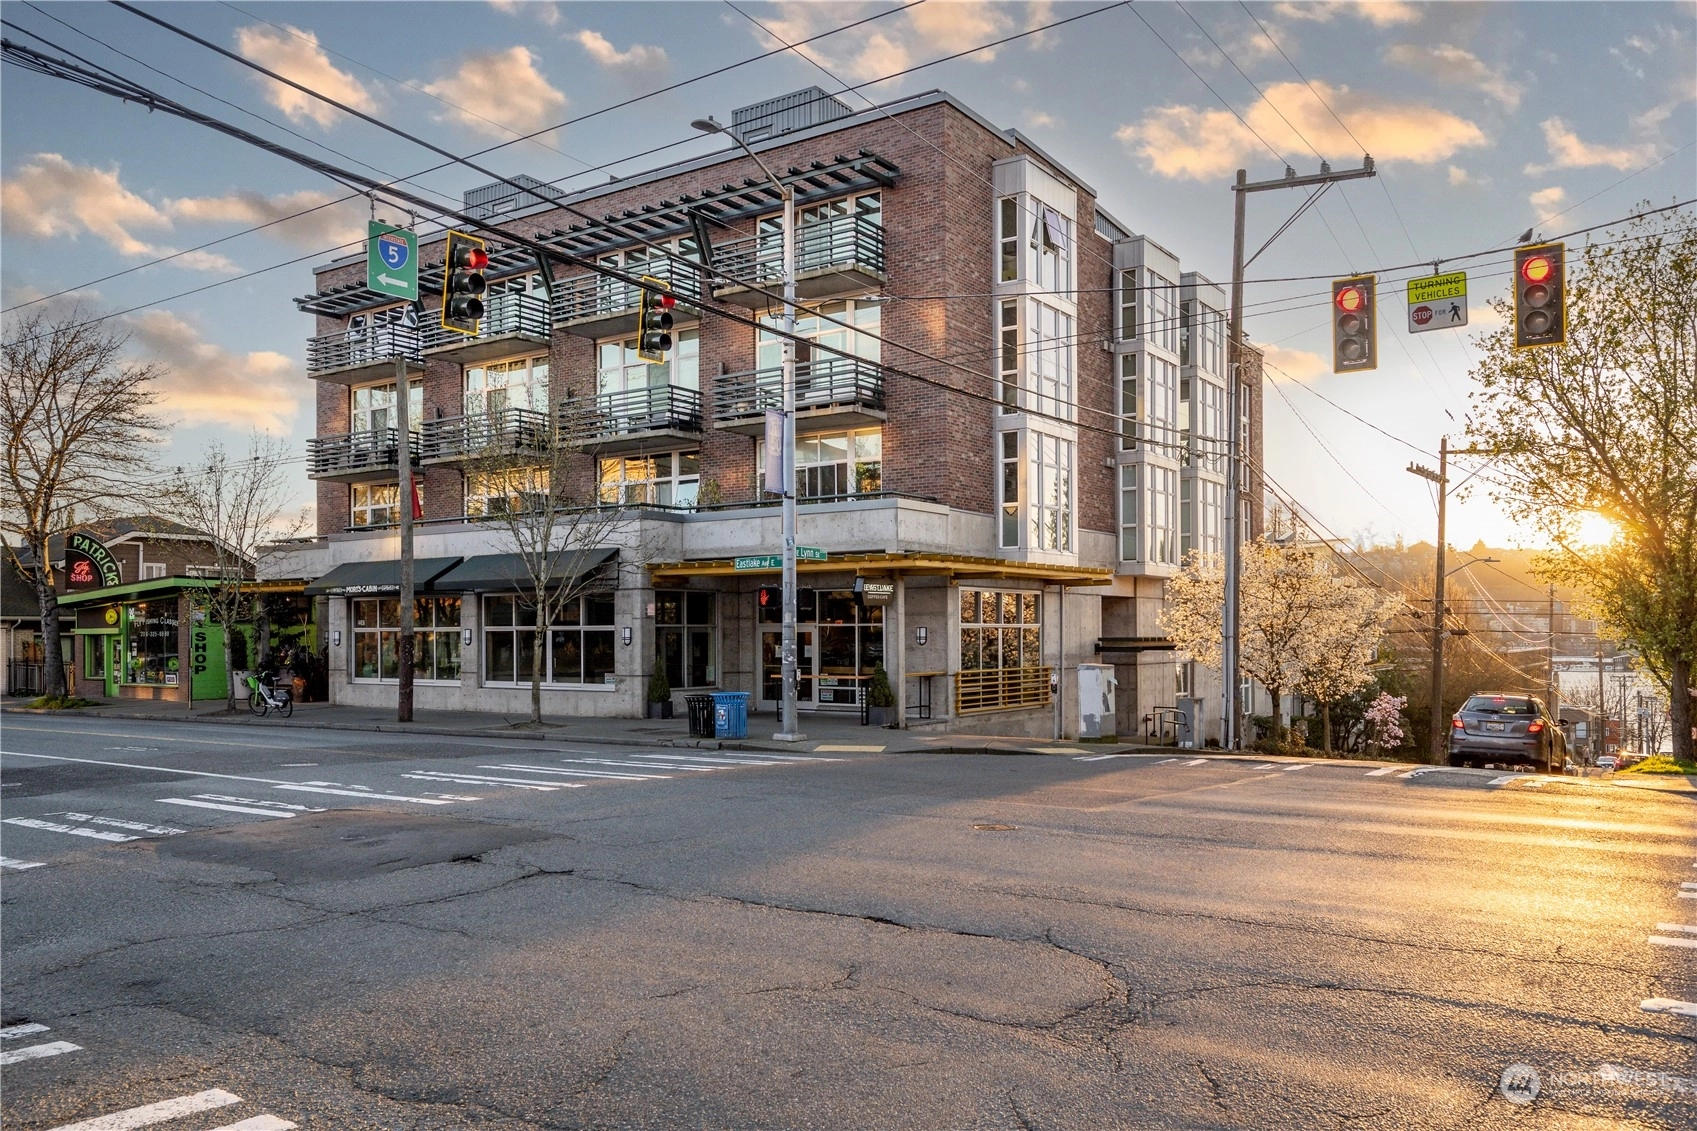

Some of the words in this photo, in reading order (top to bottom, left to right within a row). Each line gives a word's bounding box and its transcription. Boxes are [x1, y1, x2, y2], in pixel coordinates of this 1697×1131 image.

[388, 245, 399, 263] 5
[1414, 276, 1460, 290] TURNING
[1414, 286, 1460, 301] VEHICLES
[1413, 310, 1432, 321] STOP
[796, 549, 800, 557] E
[800, 547, 814, 558] Lynn
[736, 558, 760, 569] Eastlake
[70, 573, 93, 582] SHOP
[194, 632, 207, 675] SHOP
